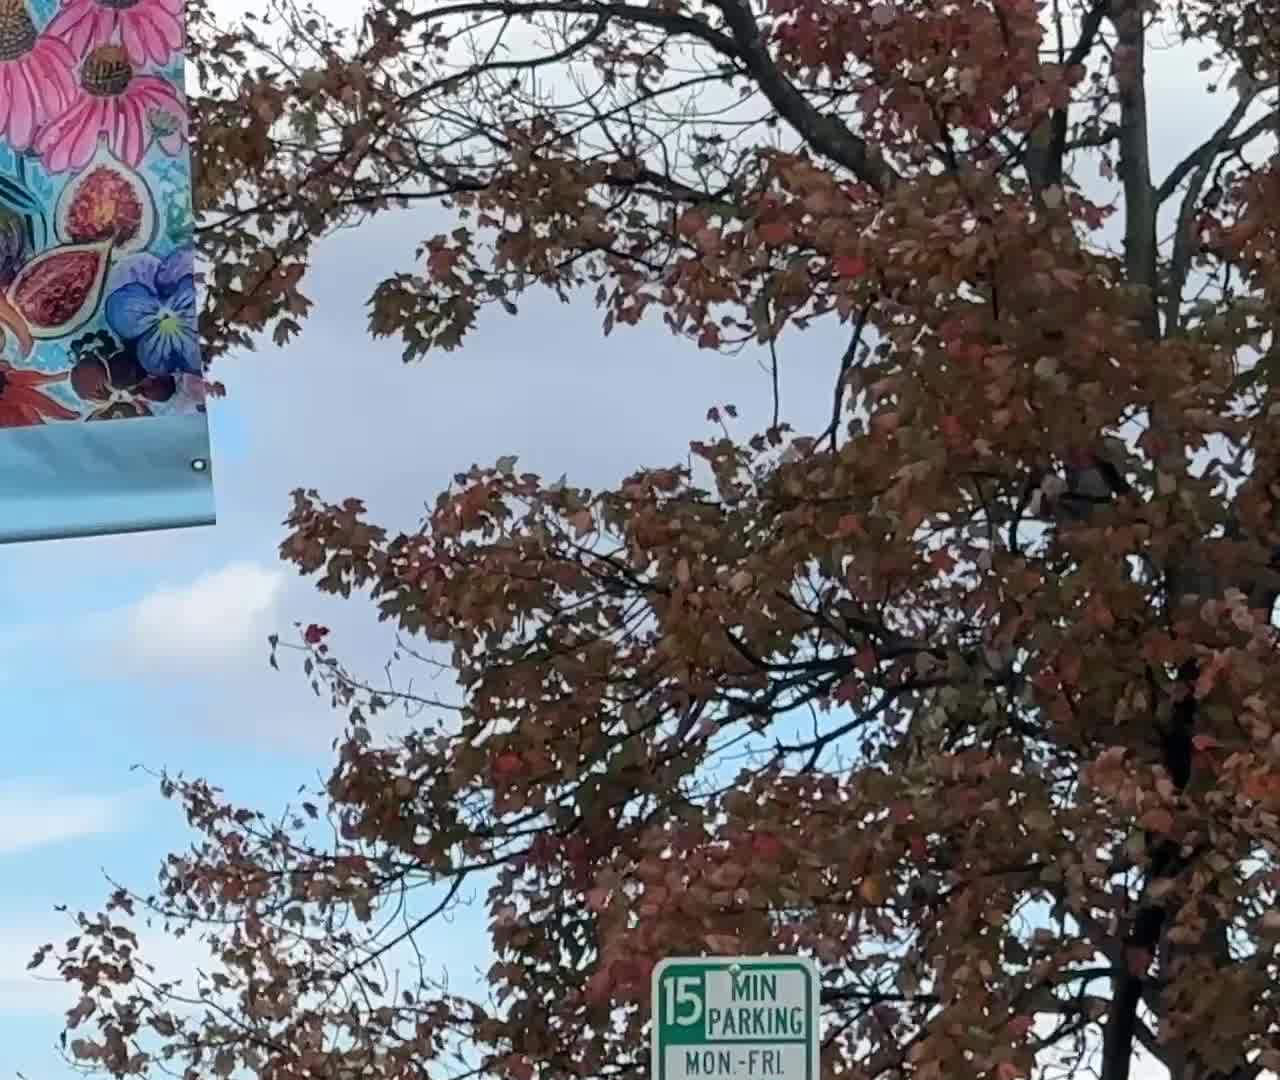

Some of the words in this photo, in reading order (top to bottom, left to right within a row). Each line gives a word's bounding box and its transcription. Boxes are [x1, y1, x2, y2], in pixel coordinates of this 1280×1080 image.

[663, 976, 703, 1026] 15
[731, 975, 777, 1001] MIN
[709, 1007, 803, 1035] PARKING
